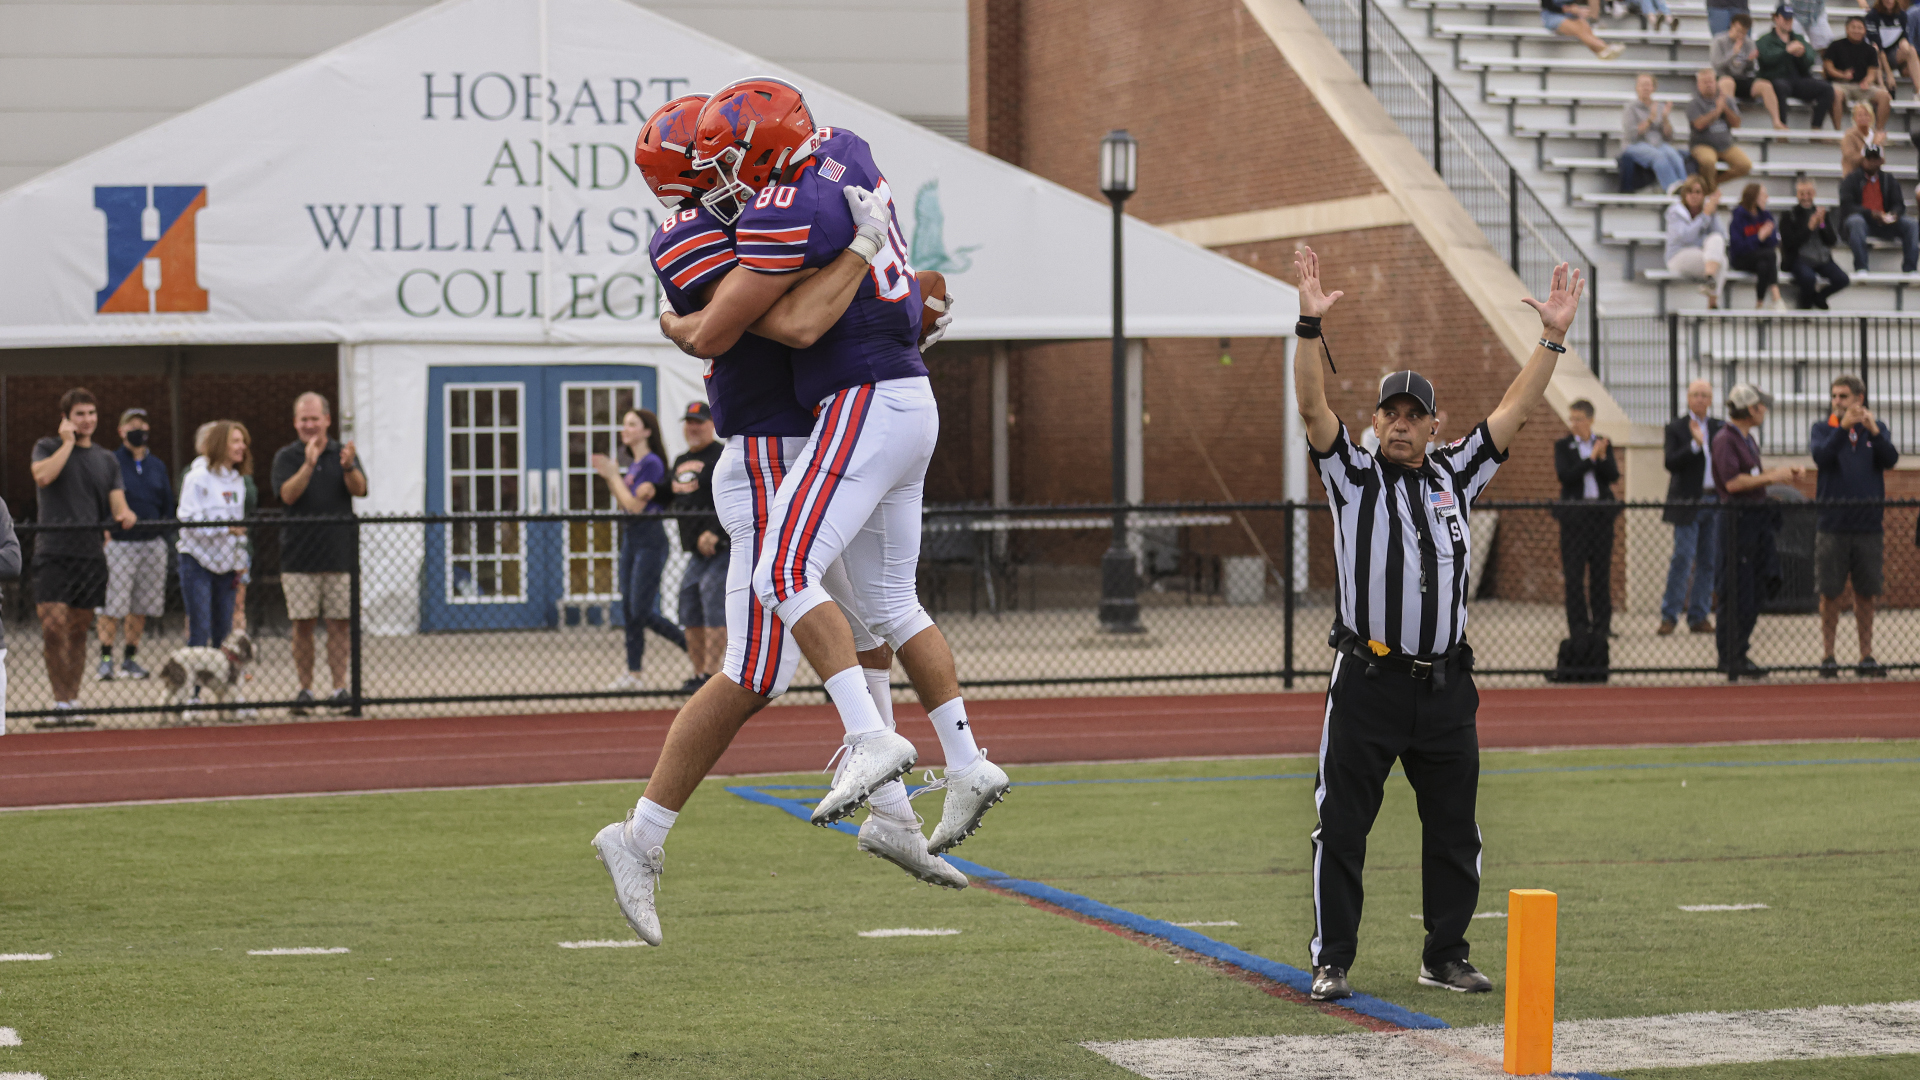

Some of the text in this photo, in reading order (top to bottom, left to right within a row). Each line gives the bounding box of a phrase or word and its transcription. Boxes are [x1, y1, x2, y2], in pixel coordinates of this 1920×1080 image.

[421, 72, 690, 125] HOBART
[483, 138, 630, 191] AND
[661, 207, 699, 234] 88
[753, 186, 798, 210] 80
[94, 185, 209, 314] H
[306, 203, 586, 256] WILLIAM
